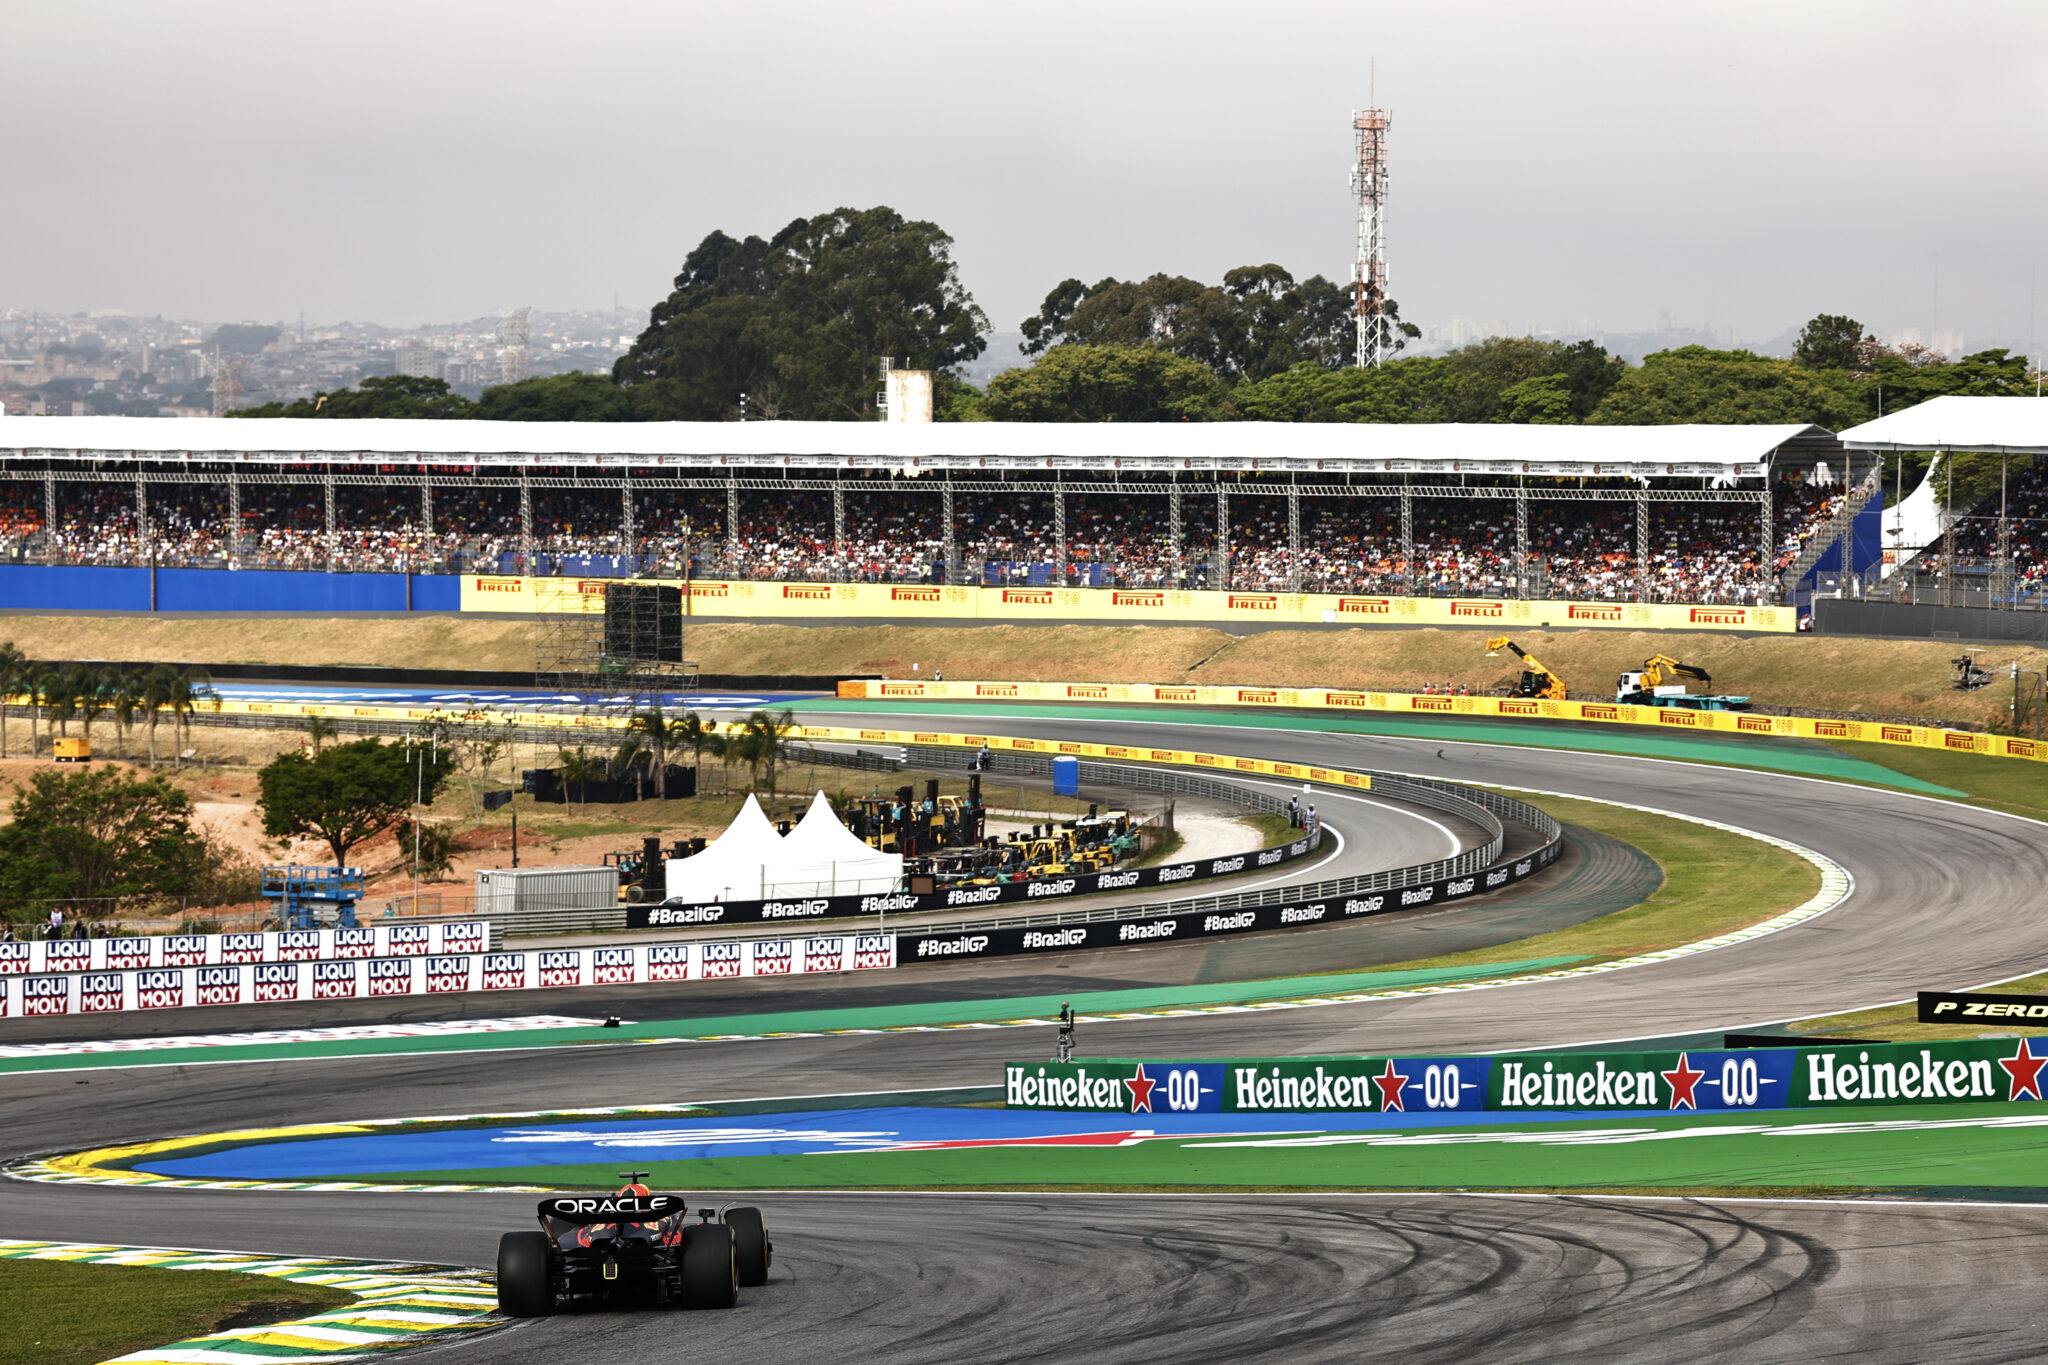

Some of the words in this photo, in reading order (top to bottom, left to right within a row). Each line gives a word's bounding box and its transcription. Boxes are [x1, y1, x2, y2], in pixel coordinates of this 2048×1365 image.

[476, 579, 521, 592] PIRELLI
[783, 585, 831, 599] PIRELLI
[891, 587, 941, 601] PIRELLI
[1002, 590, 1053, 604] PIRELLI
[1112, 592, 1164, 606] PIRELLI
[1228, 595, 1277, 609] PIRELLI
[1339, 598, 1390, 613] PIRELLI
[1450, 601, 1503, 617] PIRELLI
[1568, 605, 1622, 620] PIRELLI
[1690, 608, 1746, 624] PIRELLI
[880, 683, 925, 695] PIRELLI
[976, 684, 1018, 696] PIRELLI
[1067, 685, 1108, 698] PIRELLI
[1155, 688, 1197, 701] PIRELLI
[1238, 690, 1277, 703] PIRELLI
[1326, 692, 1366, 706] PIRELLI
[1412, 696, 1453, 710] PIRELLI
[1498, 700, 1539, 714] PIRELLI
[1581, 704, 1618, 719] PIRELLI
[1659, 710, 1696, 726] PIRELLI
[1737, 716, 1772, 732] PIRELLI
[1815, 721, 1846, 737] PIRELLI
[1881, 726, 1913, 742] PIRELLI
[1946, 734, 1973, 749] PIRELLI
[2008, 740, 2034, 756] PIRELLI
[1213, 857, 1245, 873] #BrazilGP
[1098, 872, 1139, 889] #BrazilGP
[1158, 865, 1196, 882] #BrazilGP
[1028, 879, 1075, 897] #BrazilGP
[1447, 878, 1474, 895] #BrazilGP
[861, 895, 918, 913] #BrazilGP
[948, 887, 1001, 905] #BrazilGP
[1402, 887, 1433, 905] #BrazilGP
[762, 900, 829, 918] #BrazilGP
[1345, 896, 1383, 914] #BrazilGP
[649, 906, 724, 925] #BrazilGP
[1204, 912, 1255, 930] #BrazilGP
[1281, 905, 1325, 922] #BrazilGP
[335, 929, 373, 945] LIQUI
[390, 927, 428, 943] LIQUI
[443, 924, 481, 940] LIQUI
[1023, 929, 1086, 947] #BrazilGP
[1120, 921, 1176, 940] #BrazilGP
[108, 940, 149, 956] LIQUI
[165, 937, 206, 953] LIQUI
[223, 935, 262, 952] LIQUI
[279, 932, 318, 948] LIQUI
[443, 940, 482, 953] MOLY
[806, 939, 842, 955] LIQUI
[856, 936, 890, 952] LIQUI
[918, 936, 988, 956] #BrazilGP
[47, 941, 90, 957] LIQUI
[222, 950, 263, 963] MOLY
[278, 948, 319, 961] MOLY
[335, 945, 374, 959] MOLY
[389, 942, 428, 956] MOLY
[649, 947, 687, 963] LIQUI
[703, 945, 740, 961] LIQUI
[754, 942, 791, 958] LIQUI
[47, 958, 90, 971] MOLY
[107, 956, 150, 970] MOLY
[164, 953, 206, 966] MOLY
[427, 958, 468, 974] LIQUI
[484, 955, 524, 971] LIQUI
[540, 952, 579, 969] LIQUI
[595, 950, 633, 966] LIQUI
[805, 955, 842, 971] MOLY
[854, 952, 890, 968] MOLY
[255, 965, 297, 983] LIQUI
[314, 963, 354, 980] LIQUI
[369, 961, 410, 977] LIQUI
[649, 963, 687, 980] MOLY
[702, 961, 741, 977] MOLY
[754, 958, 791, 975] MOLY
[139, 971, 181, 990] LIQUI
[198, 968, 239, 986] LIQUI
[483, 972, 524, 989] MOLY
[540, 969, 579, 986] MOLY
[594, 967, 634, 983] MOLY
[24, 978, 67, 997] LIQUI
[82, 975, 122, 993] LIQUI
[313, 981, 355, 998] MOLY
[369, 977, 410, 995] MOLY
[427, 975, 468, 992] MOLY
[139, 990, 182, 1008] MOLY
[197, 986, 239, 1004] MOLY
[255, 983, 297, 1001] MOLY
[24, 997, 67, 1014] MOLY
[82, 993, 122, 1011] MOLY
[1934, 1002, 1957, 1014] P
[1962, 1003, 2048, 1018] ZERO
[1501, 1062, 1658, 1107] Heineken
[1721, 1058, 1758, 1106] 0.0
[1807, 1050, 1995, 1101] Heineken
[1006, 1067, 1124, 1107] Heineken
[1168, 1070, 1199, 1110] 0.0
[1235, 1067, 1372, 1108] Heineken
[1425, 1065, 1460, 1108] 0.0
[554, 1197, 668, 1213] ORACLE
